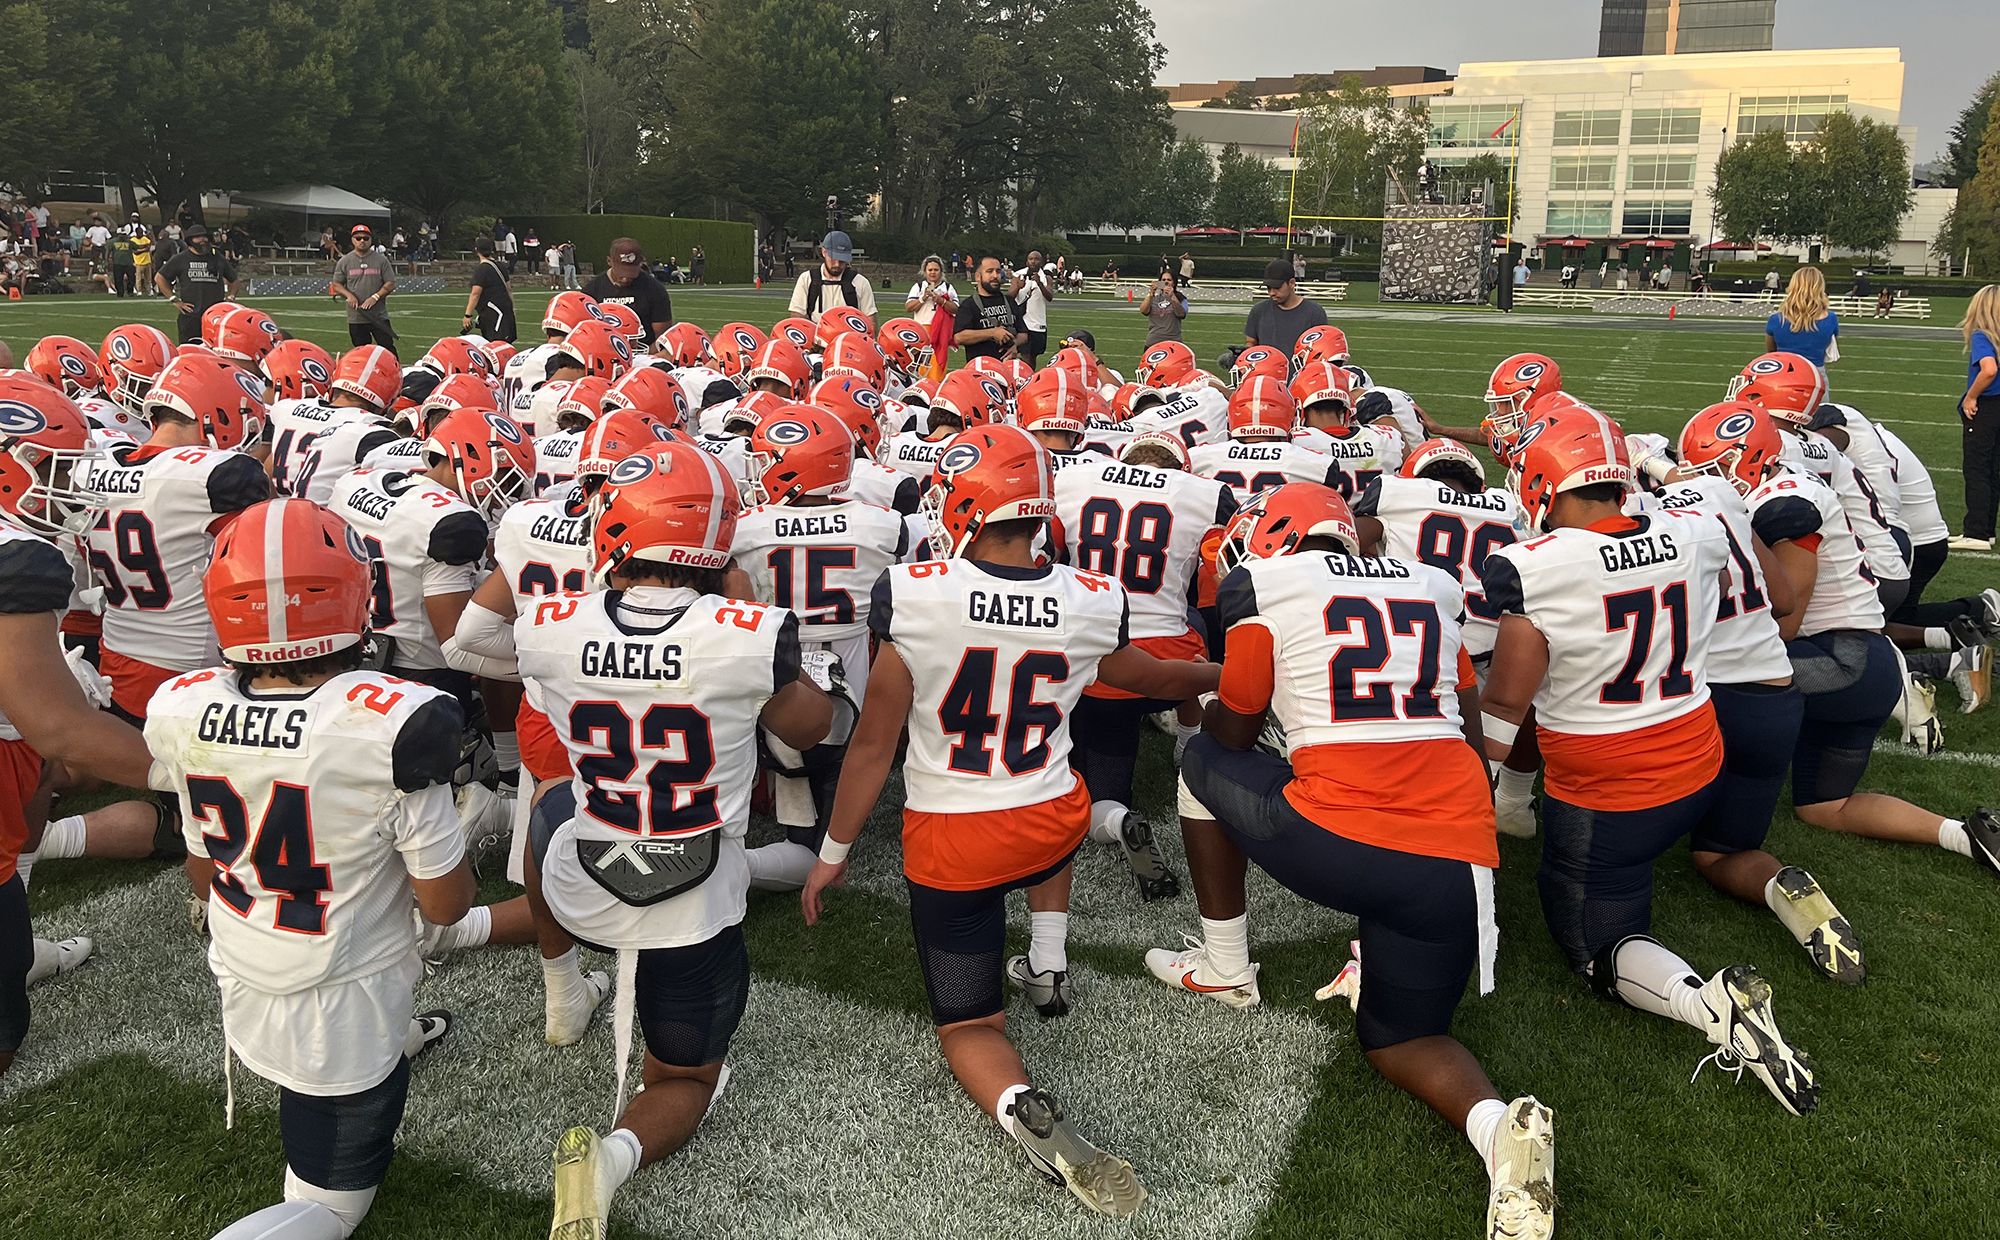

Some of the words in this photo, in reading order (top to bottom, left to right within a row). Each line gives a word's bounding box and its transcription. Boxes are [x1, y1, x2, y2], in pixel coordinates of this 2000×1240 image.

[751, 369, 780, 378] Riddell
[825, 369, 854, 377] Riddell
[1515, 362, 1545, 381] G
[1750, 359, 1783, 375] G
[146, 391, 172, 405] ddell
[341, 380, 376, 401] Riddell
[1316, 390, 1348, 400] Riddell
[292, 403, 336, 422] GAELS
[1156, 396, 1198, 419] GAELS
[765, 420, 810, 446] G
[1042, 420, 1079, 430] Riddell
[1240, 428, 1275, 436] Riddell
[1715, 412, 1756, 441] G
[387, 441, 423, 456] GAEL
[543, 440, 578, 458] GAELS
[605, 441, 618, 450] 55
[899, 445, 944, 462] GAELS
[1228, 446, 1282, 460] GAELS
[1331, 441, 1374, 458] GAELS
[1428, 446, 1474, 458] Riddell
[1803, 442, 1828, 460] GAELS
[937, 443, 981, 476] G
[89, 468, 144, 494] GAELS
[1101, 466, 1167, 490] GAELS
[1584, 467, 1631, 482] Riddell
[348, 487, 396, 521] GAELS
[1017, 502, 1056, 516] Ridde
[775, 514, 847, 538] GAELS
[1077, 496, 1174, 595] 88
[1599, 533, 1679, 573] GAELS
[668, 549, 727, 568] Riddell
[1324, 554, 1409, 579] GAELS
[767, 546, 856, 625] 15
[969, 590, 1059, 628] GAELS
[246, 639, 333, 662] Riddell
[1599, 580, 1694, 704] 71
[581, 640, 682, 681] GAELS
[1322, 595, 1447, 723] 27
[937, 647, 1070, 777] 46
[198, 702, 308, 750] GAELS
[568, 700, 724, 836] 22
[185, 773, 333, 935] 24
